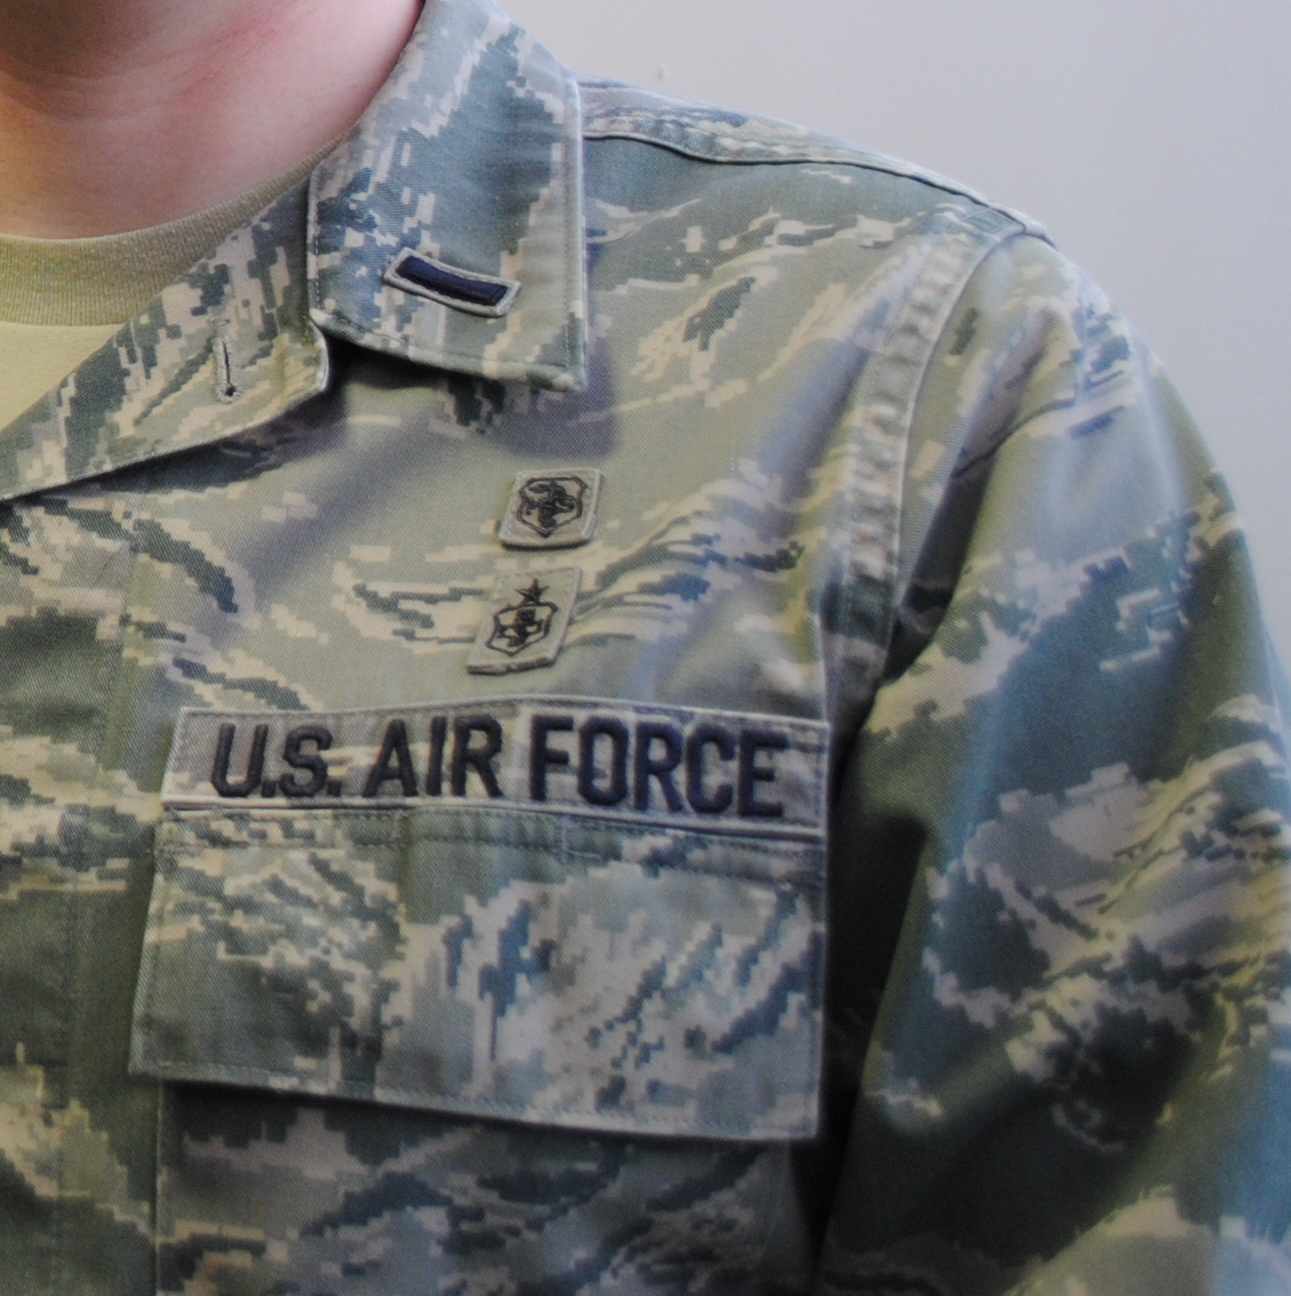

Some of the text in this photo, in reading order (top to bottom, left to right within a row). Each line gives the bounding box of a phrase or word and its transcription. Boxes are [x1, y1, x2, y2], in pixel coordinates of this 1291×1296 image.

[209, 714, 793, 819] U.S. AIR FORCE
